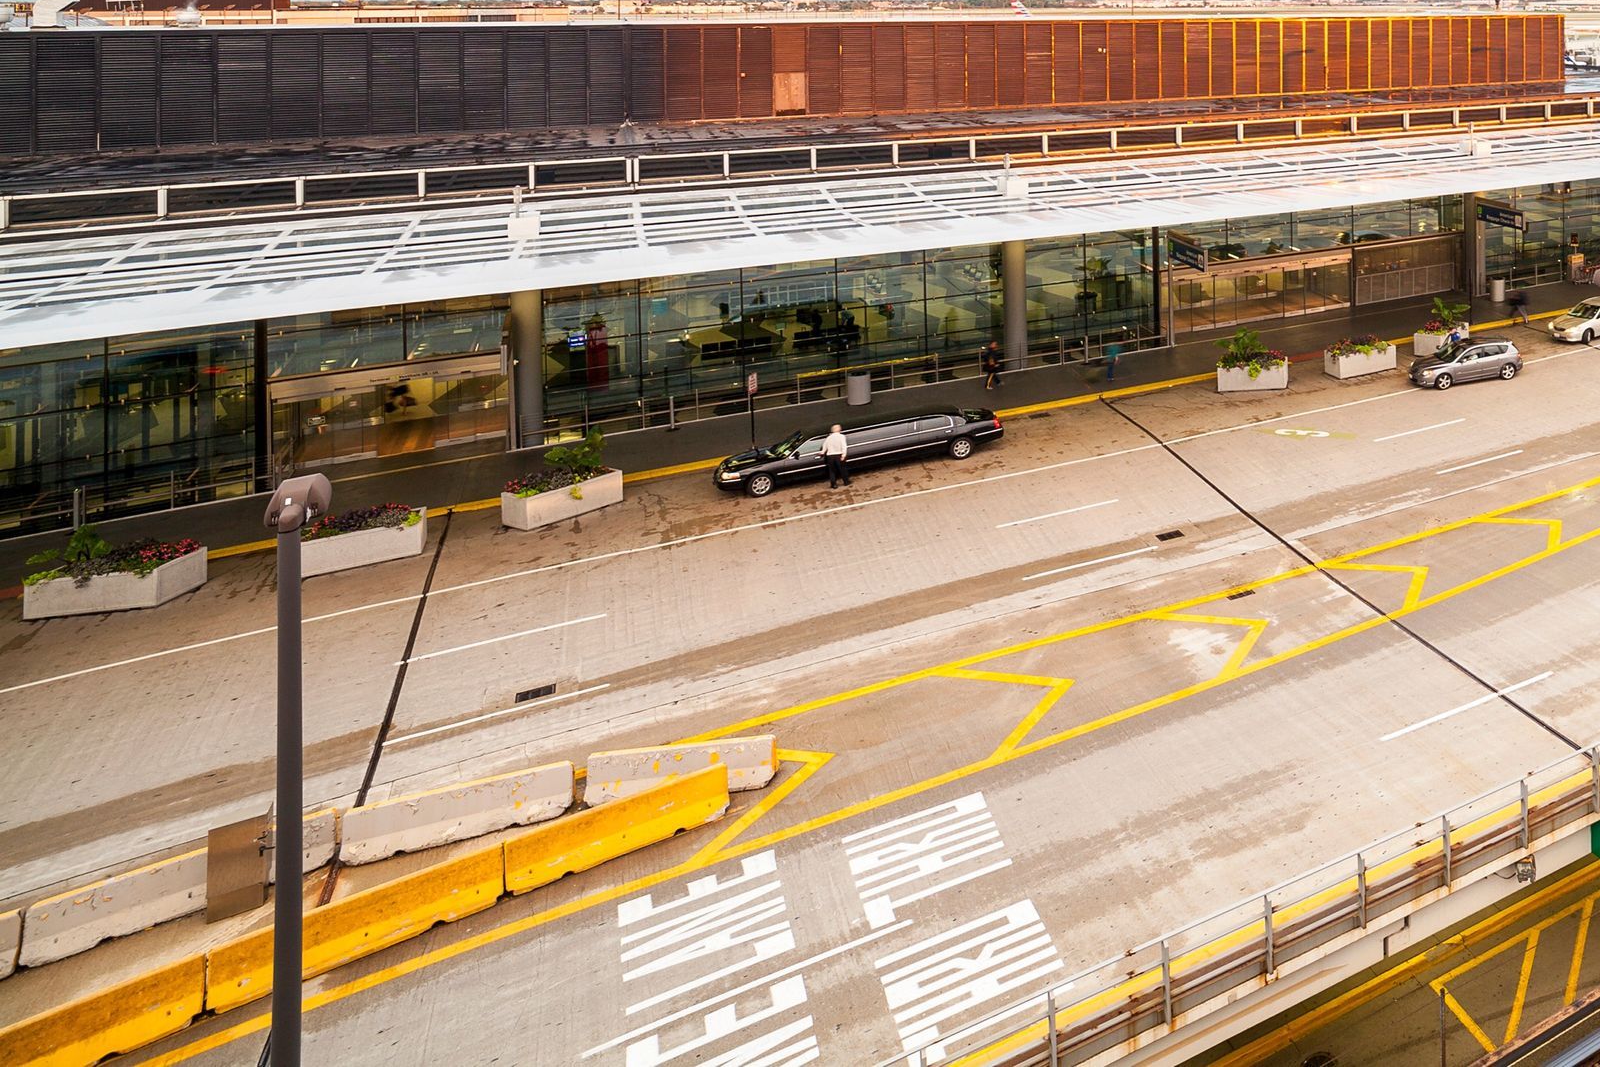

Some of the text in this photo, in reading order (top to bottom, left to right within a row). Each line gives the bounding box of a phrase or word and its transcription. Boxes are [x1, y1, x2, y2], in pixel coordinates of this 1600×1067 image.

[617, 849, 796, 1017] LANE
[841, 791, 1013, 930] THRU
[874, 898, 1075, 1067] THRU
